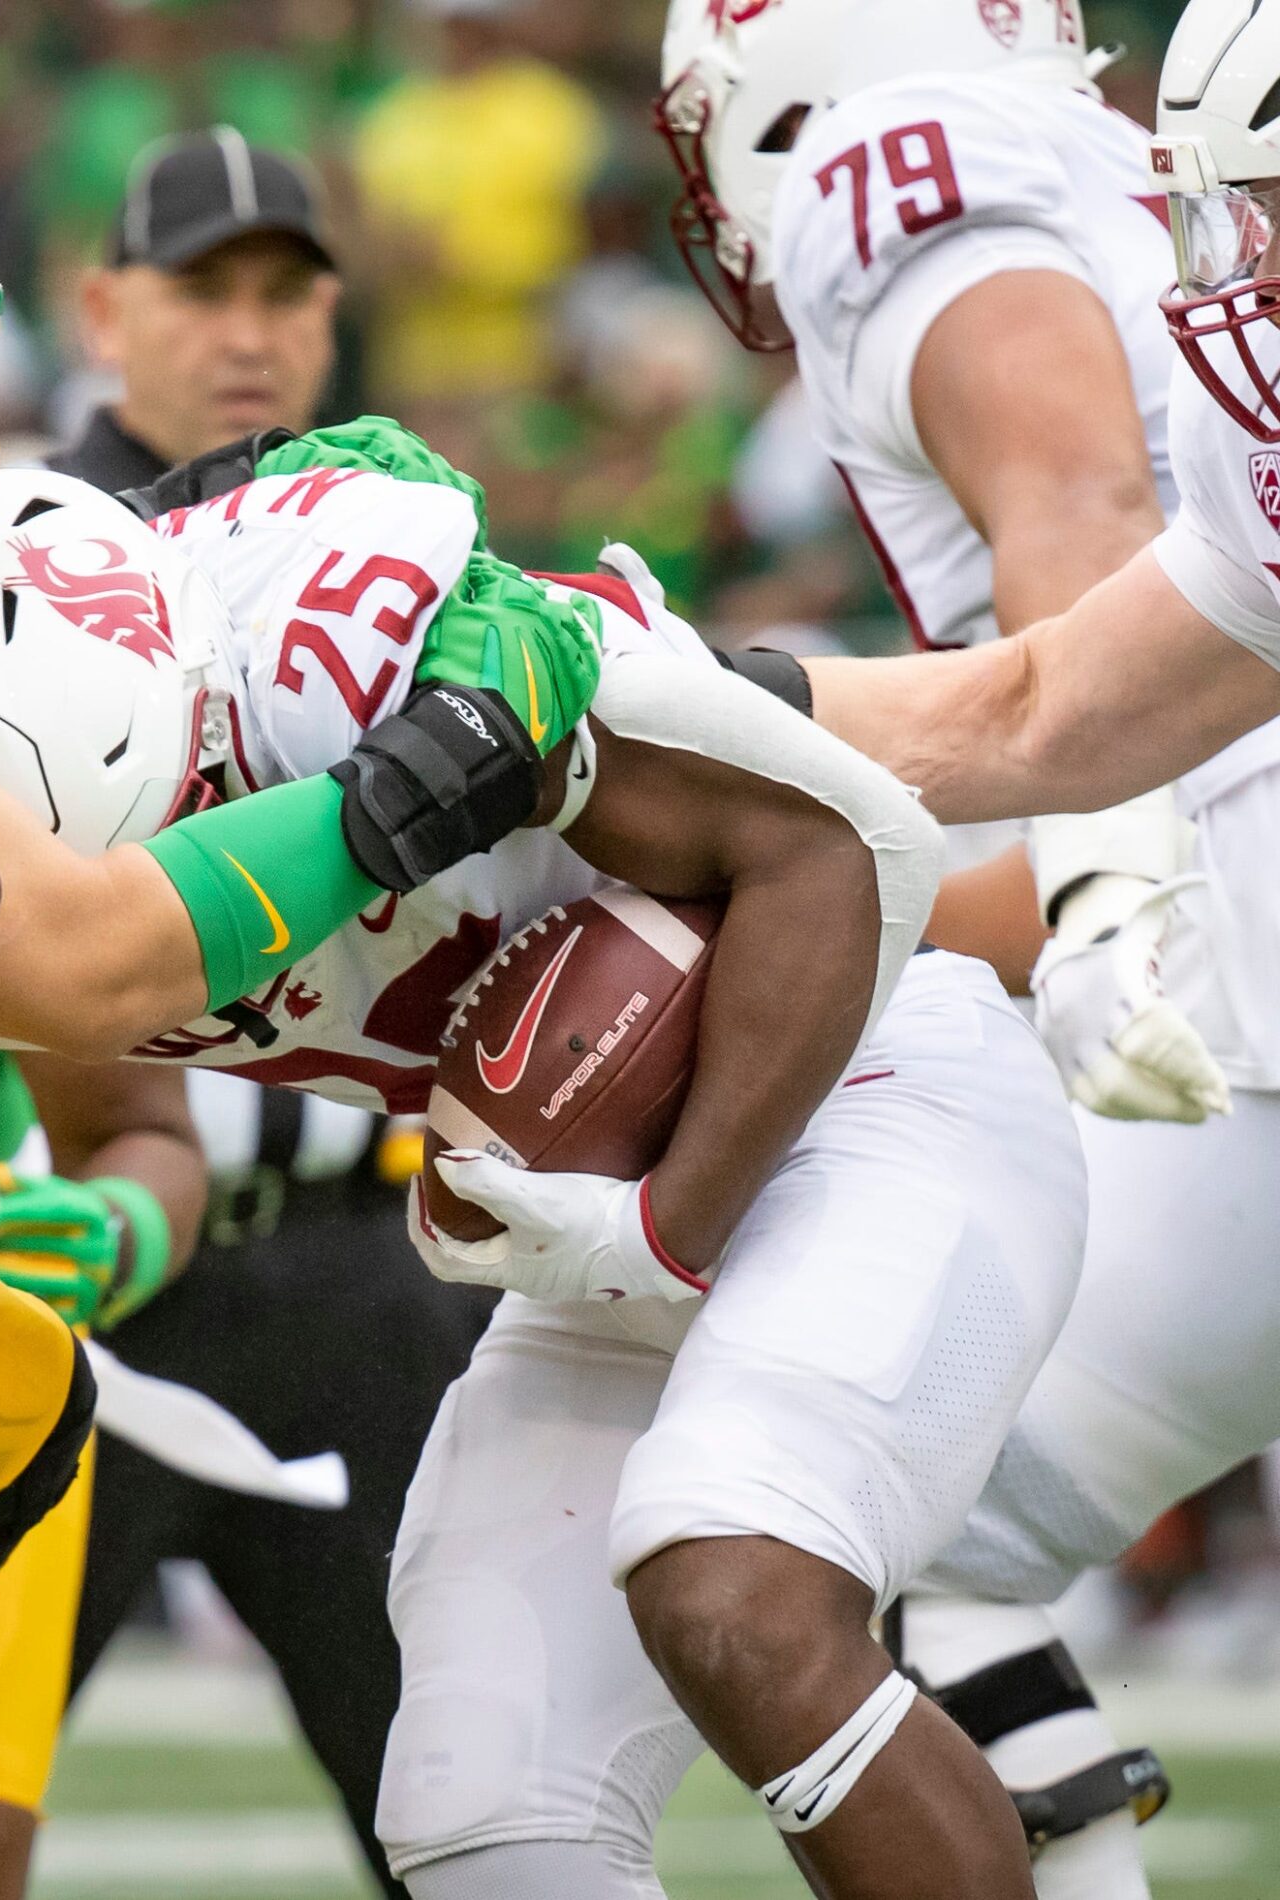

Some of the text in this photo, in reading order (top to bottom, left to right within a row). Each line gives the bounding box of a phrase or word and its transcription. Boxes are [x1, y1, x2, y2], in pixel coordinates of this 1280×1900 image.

[814, 121, 964, 270] 79
[273, 550, 439, 730] 25
[539, 991, 650, 1120] VAPOR ELITE
